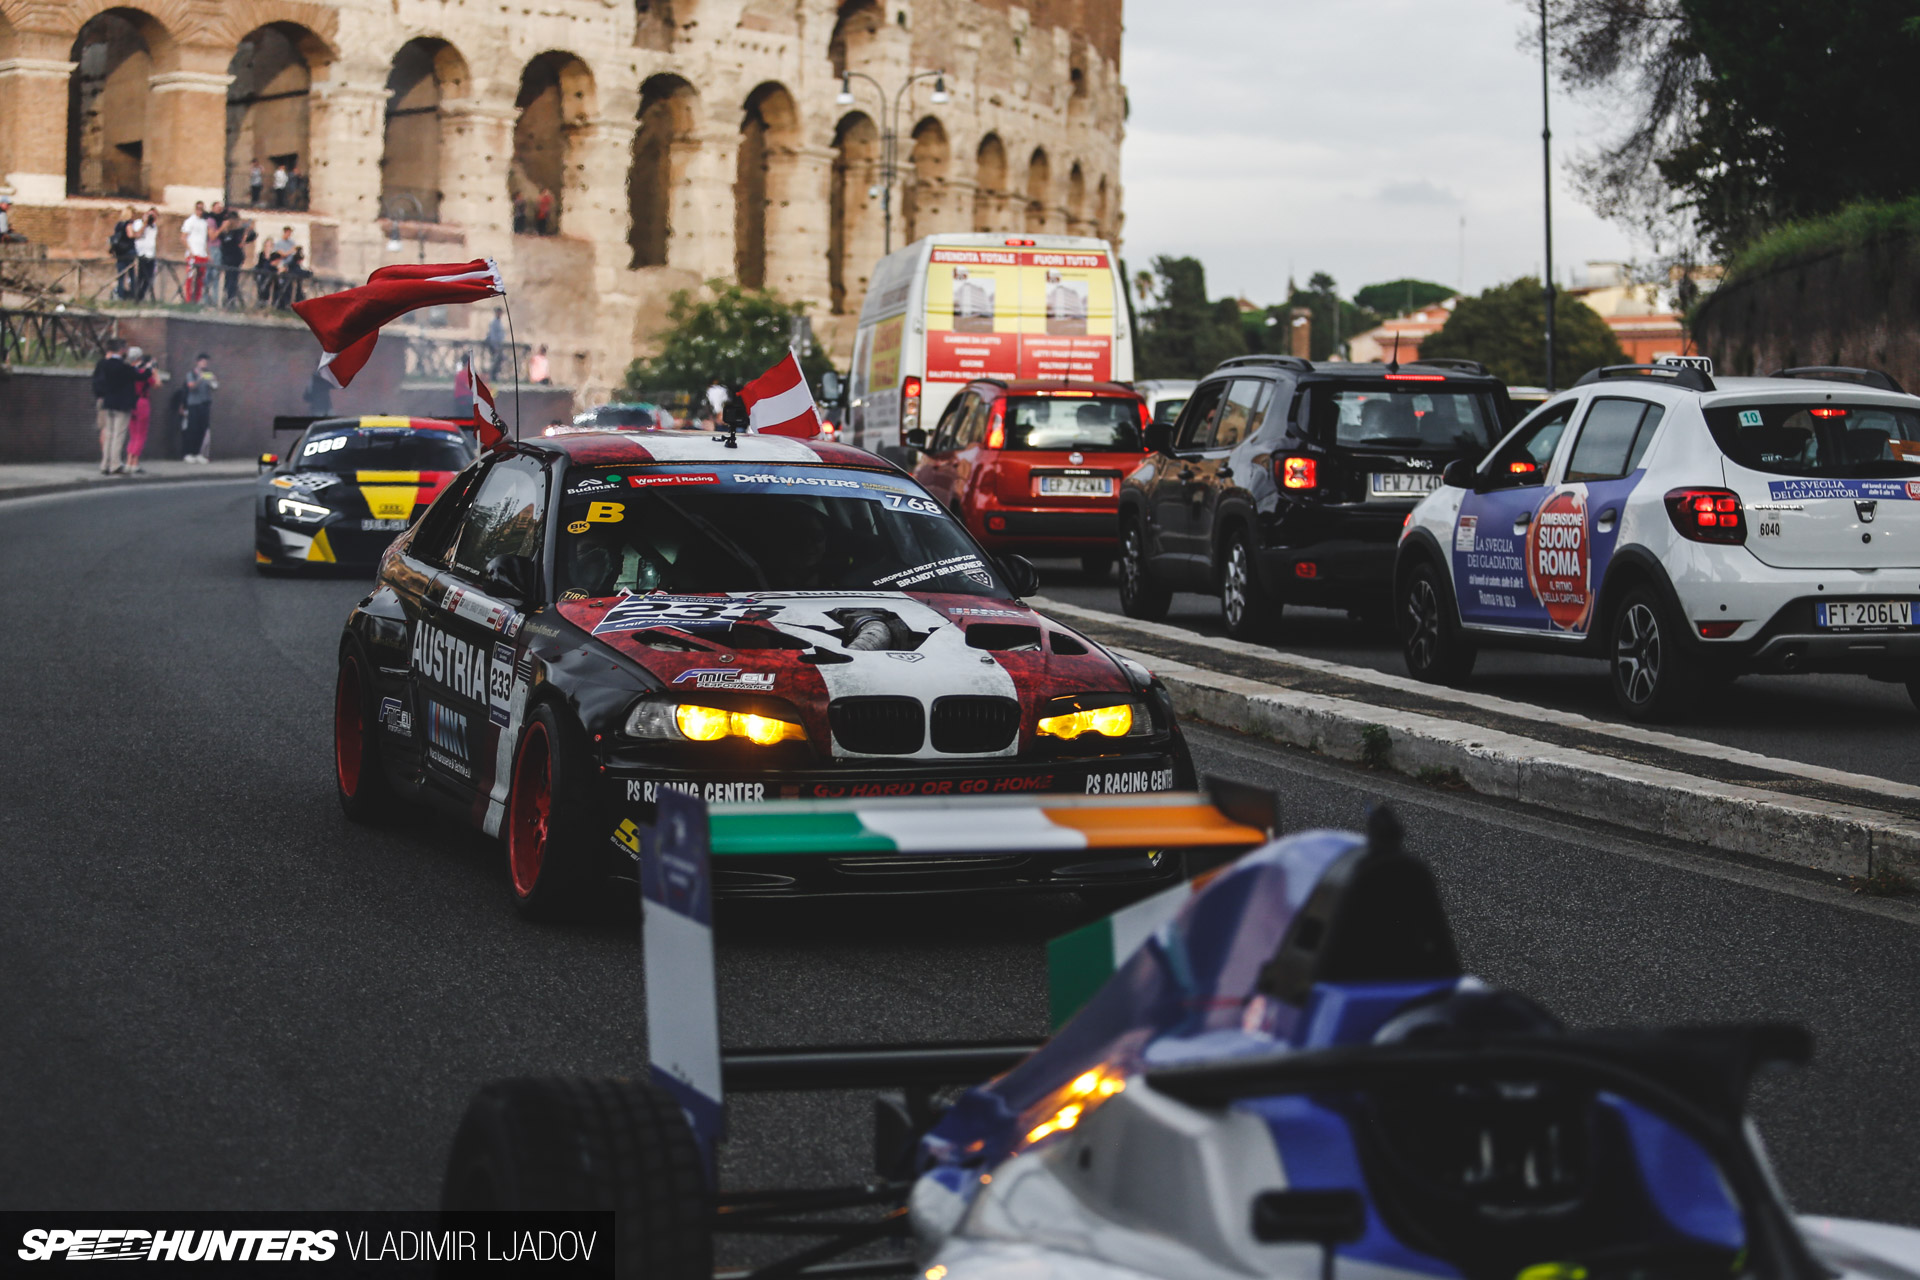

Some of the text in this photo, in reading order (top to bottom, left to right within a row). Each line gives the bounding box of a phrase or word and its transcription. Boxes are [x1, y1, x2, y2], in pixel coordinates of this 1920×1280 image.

[934, 251, 1015, 264] SVENDITA TOTALE
[1033, 254, 1098, 266] FUORI TUTTO
[1668, 359, 1708, 373] TAXI
[1743, 412, 1759, 423] 10
[1406, 457, 1433, 470] Jeep
[635, 475, 674, 485] Warter
[1784, 480, 1845, 490] LA SVEGLIA
[1773, 489, 1859, 500] DEI GLADIATORI
[585, 501, 626, 523] B
[885, 494, 942, 515] 768
[570, 522, 588, 530] BK
[1540, 512, 1583, 526] DIMENSIONE
[1759, 523, 1780, 536] 6040
[1539, 527, 1580, 549] SUONO
[1467, 554, 1523, 570] DEI GLADIATORI
[1539, 549, 1581, 576] ROMA
[872, 569, 914, 587] EUROPEAN
[938, 554, 977, 566] CHAMPION
[896, 560, 985, 588] BRANDY BRANDNER
[1550, 581, 1573, 591] IL RITMO
[1478, 589, 1495, 606] Roma
[1542, 593, 1584, 604] DELLA CAPITALE
[1828, 603, 1909, 624] FT 206LV
[411, 619, 487, 706] AUSTRIA
[491, 667, 511, 702] 233
[696, 682, 774, 691] PERFORMANCE
[813, 783, 845, 799] GO
[921, 780, 953, 795] OR
[959, 778, 989, 793] GO
[993, 774, 1055, 792] HOME
[1085, 773, 1101, 795] PS
[1104, 771, 1149, 794] RACING
[627, 780, 640, 802] PS
[704, 782, 765, 803] CENTER
